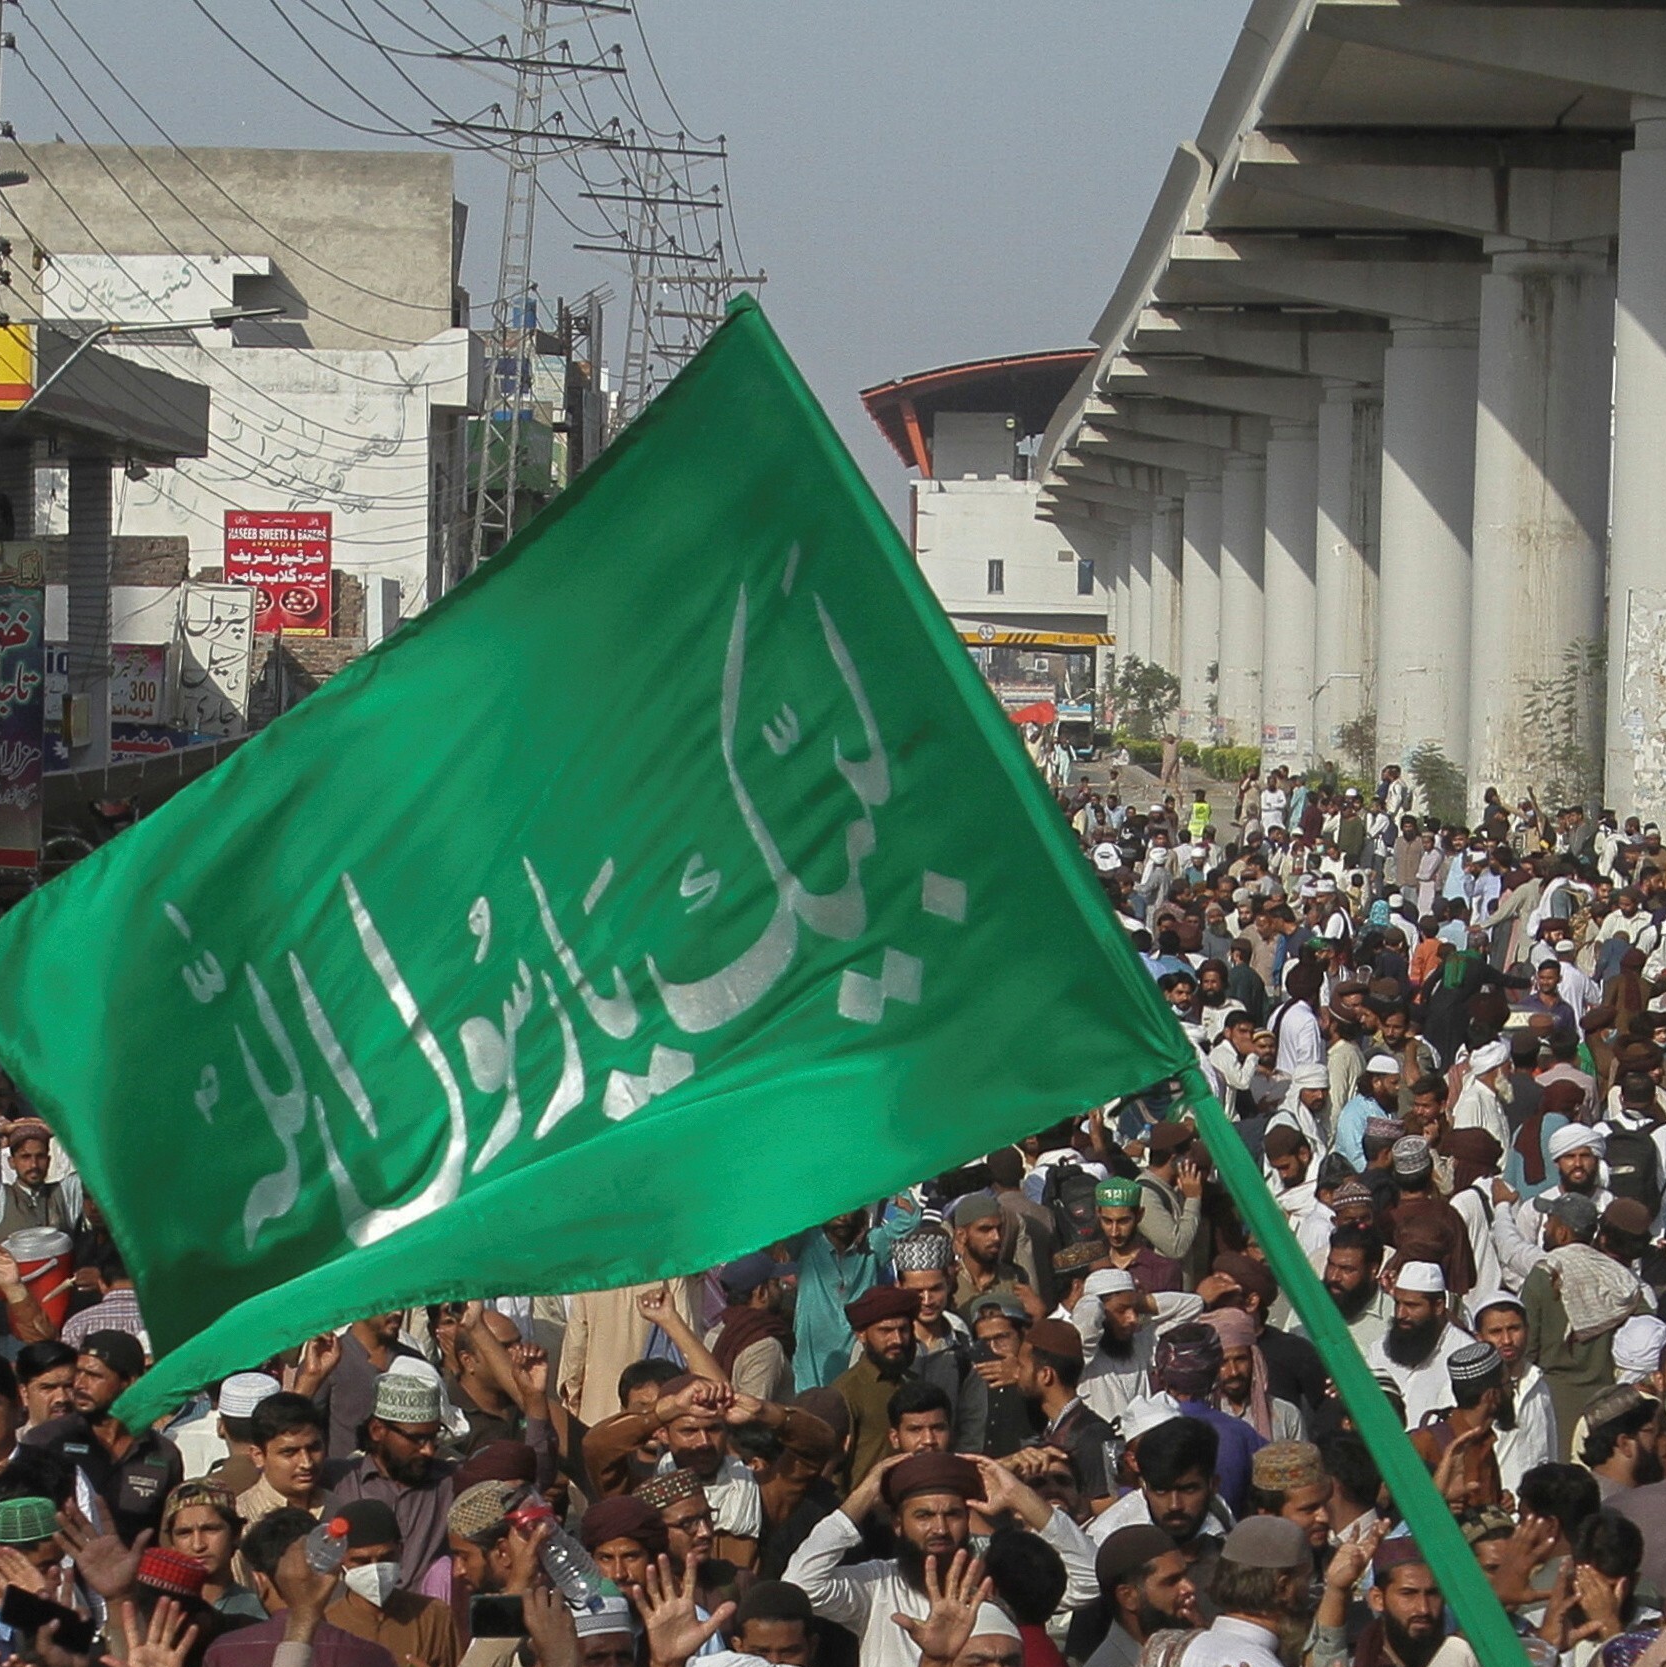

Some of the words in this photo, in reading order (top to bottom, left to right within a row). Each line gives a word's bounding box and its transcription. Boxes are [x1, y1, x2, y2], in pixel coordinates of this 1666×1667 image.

[259, 528, 289, 540] SWEETS
[290, 529, 296, 540] &
[264, 568, 298, 586] گلاب
[185, 594, 251, 641] پٹرول
[129, 681, 156, 702] 300
